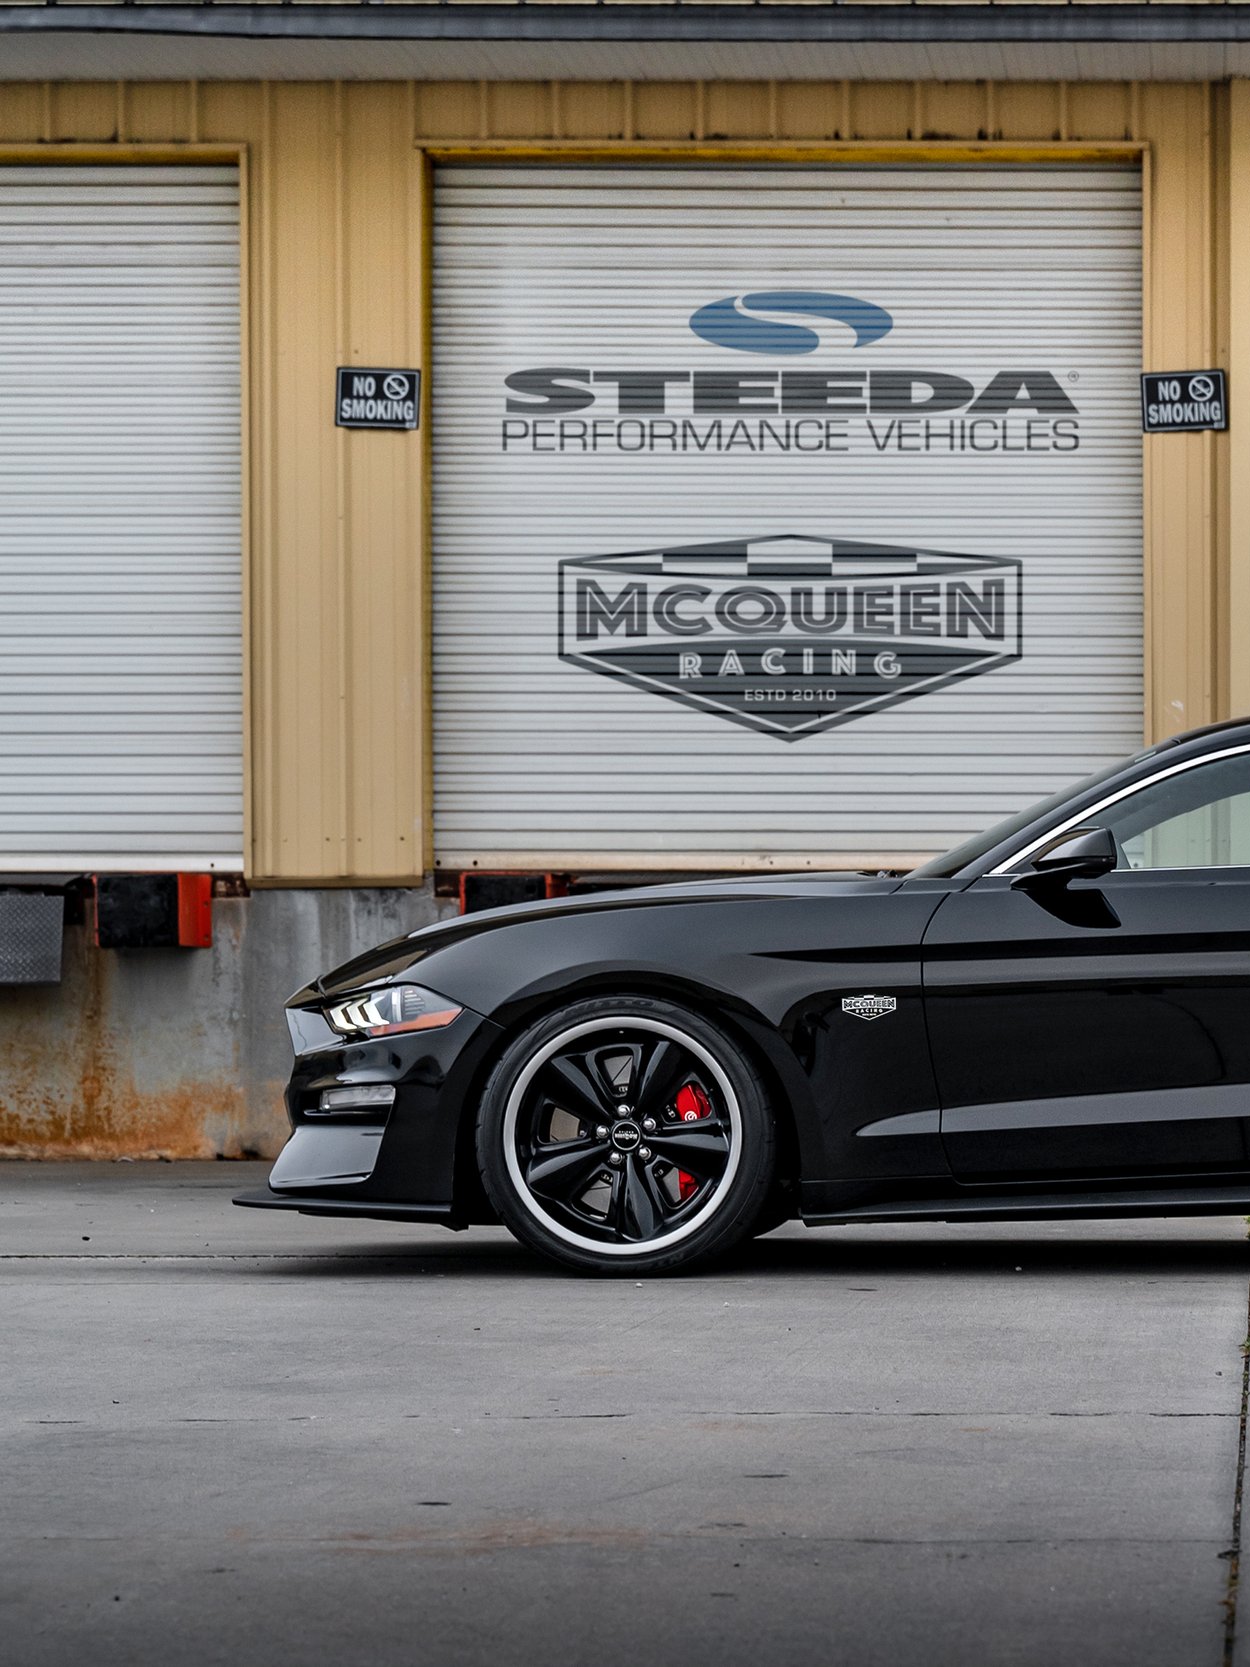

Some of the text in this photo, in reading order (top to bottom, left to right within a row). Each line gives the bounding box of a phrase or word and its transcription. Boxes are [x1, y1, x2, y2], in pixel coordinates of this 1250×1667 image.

[353, 376, 376, 397] NO
[1158, 380, 1181, 401] NO
[341, 398, 414, 420] SMOKING
[1148, 401, 1221, 424] SMOKING
[502, 419, 1080, 451] PERFORMANCE VEHICLES
[576, 578, 1005, 641] MCQUEEN
[679, 648, 902, 680] RACING
[744, 689, 837, 701] ESTD 2010
[843, 1000, 895, 1009] MCQUEEN
